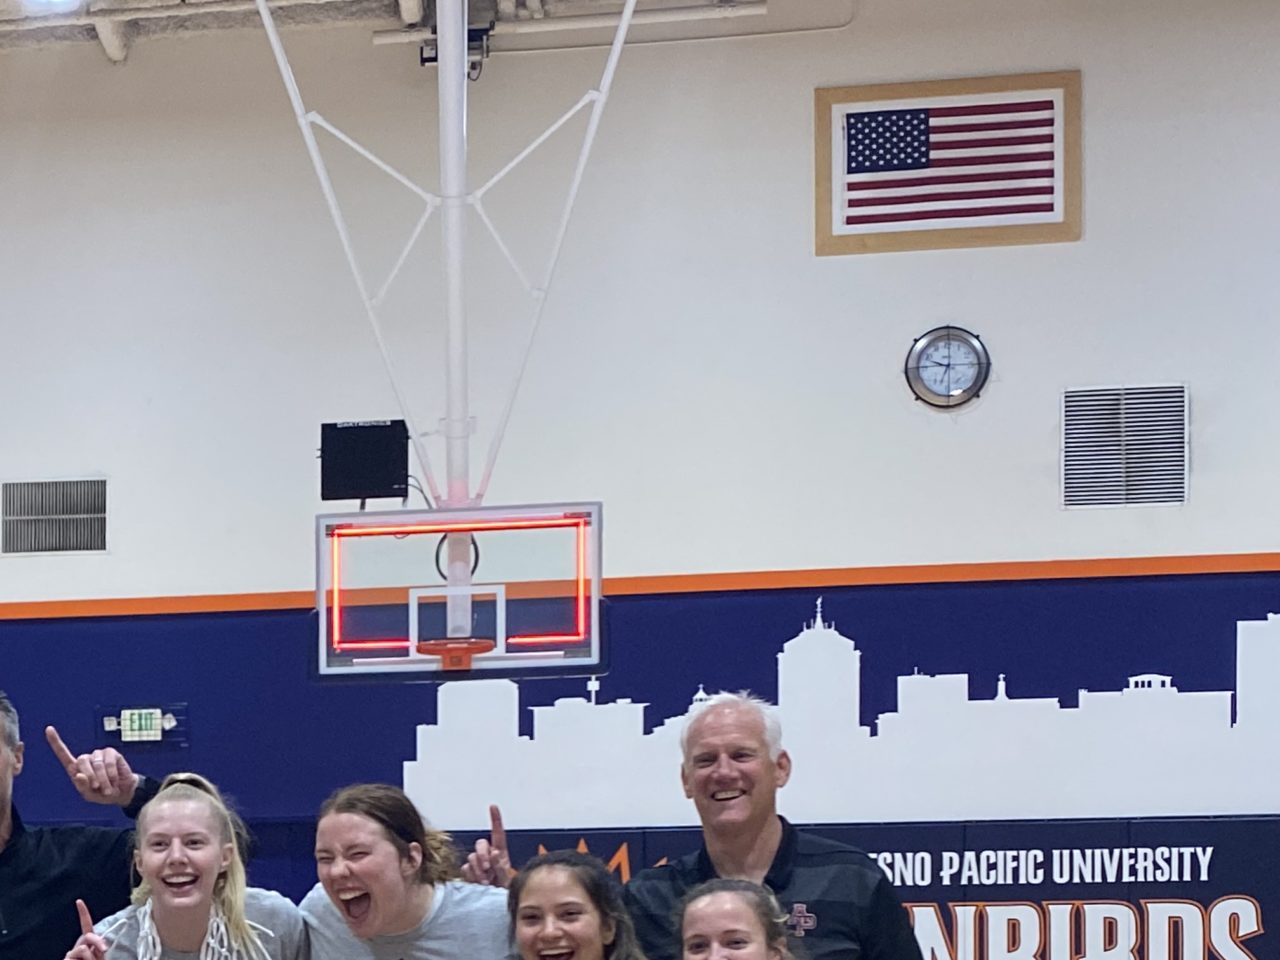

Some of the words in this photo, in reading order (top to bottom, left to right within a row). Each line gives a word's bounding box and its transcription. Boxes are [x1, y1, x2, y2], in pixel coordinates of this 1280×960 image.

[130, 712, 154, 731] EXIT
[940, 850, 1044, 885] PACIFIC
[1052, 846, 1214, 883] UNIVERSITY
